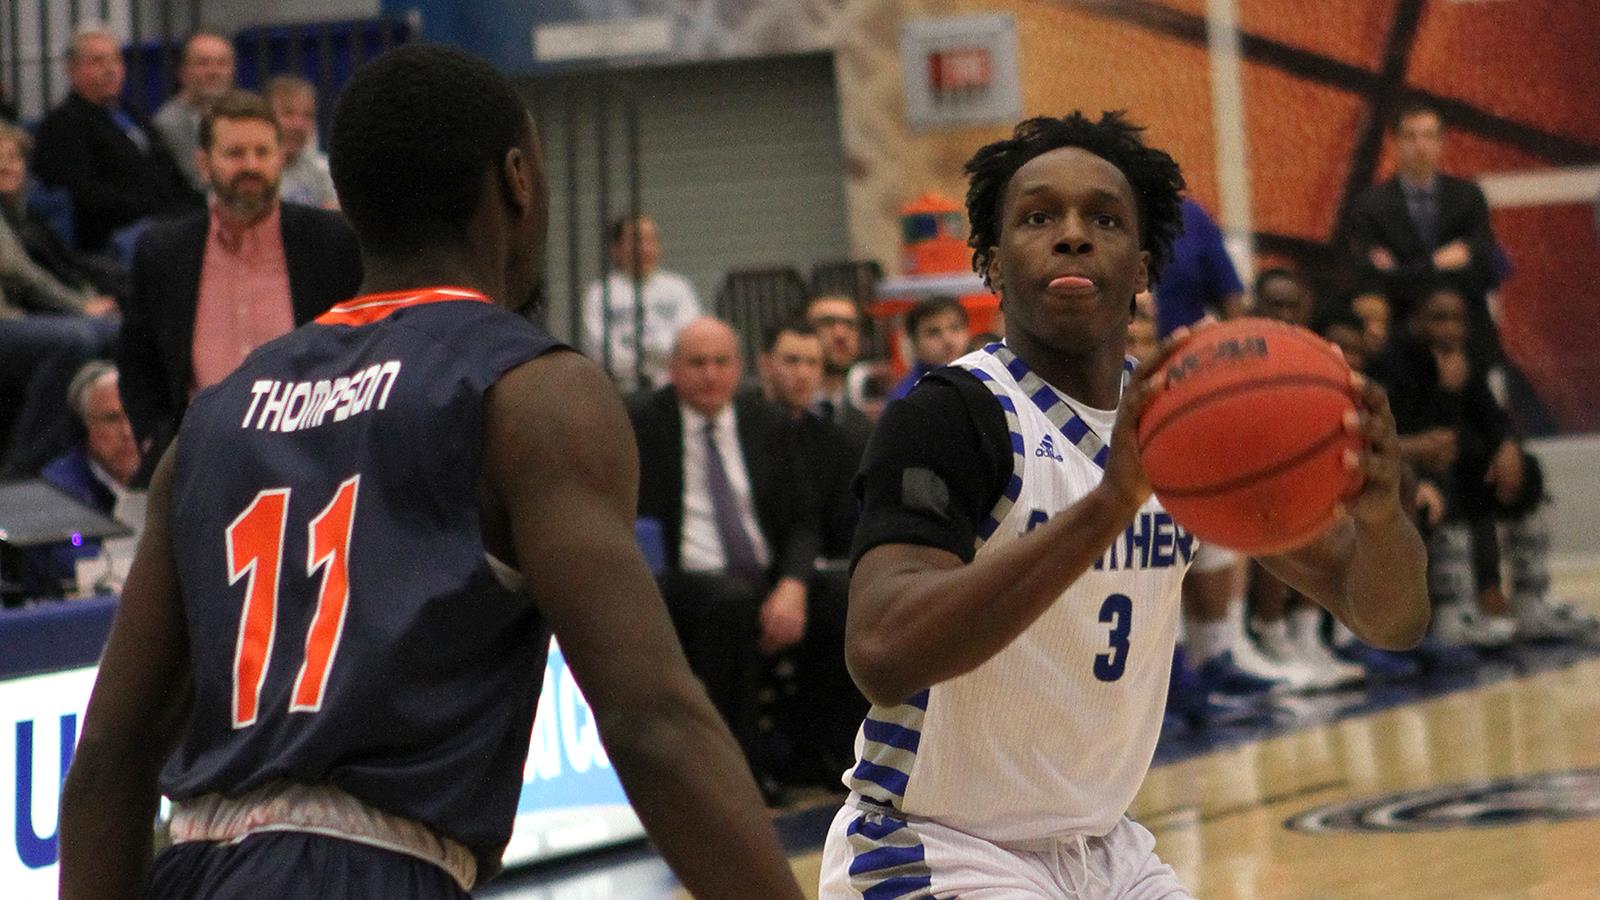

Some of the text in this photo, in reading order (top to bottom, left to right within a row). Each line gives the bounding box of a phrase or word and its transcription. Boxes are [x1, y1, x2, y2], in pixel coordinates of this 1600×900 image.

[241, 360, 401, 433] THOMPSON
[225, 473, 361, 729] 11
[1093, 593, 1132, 682] 3
